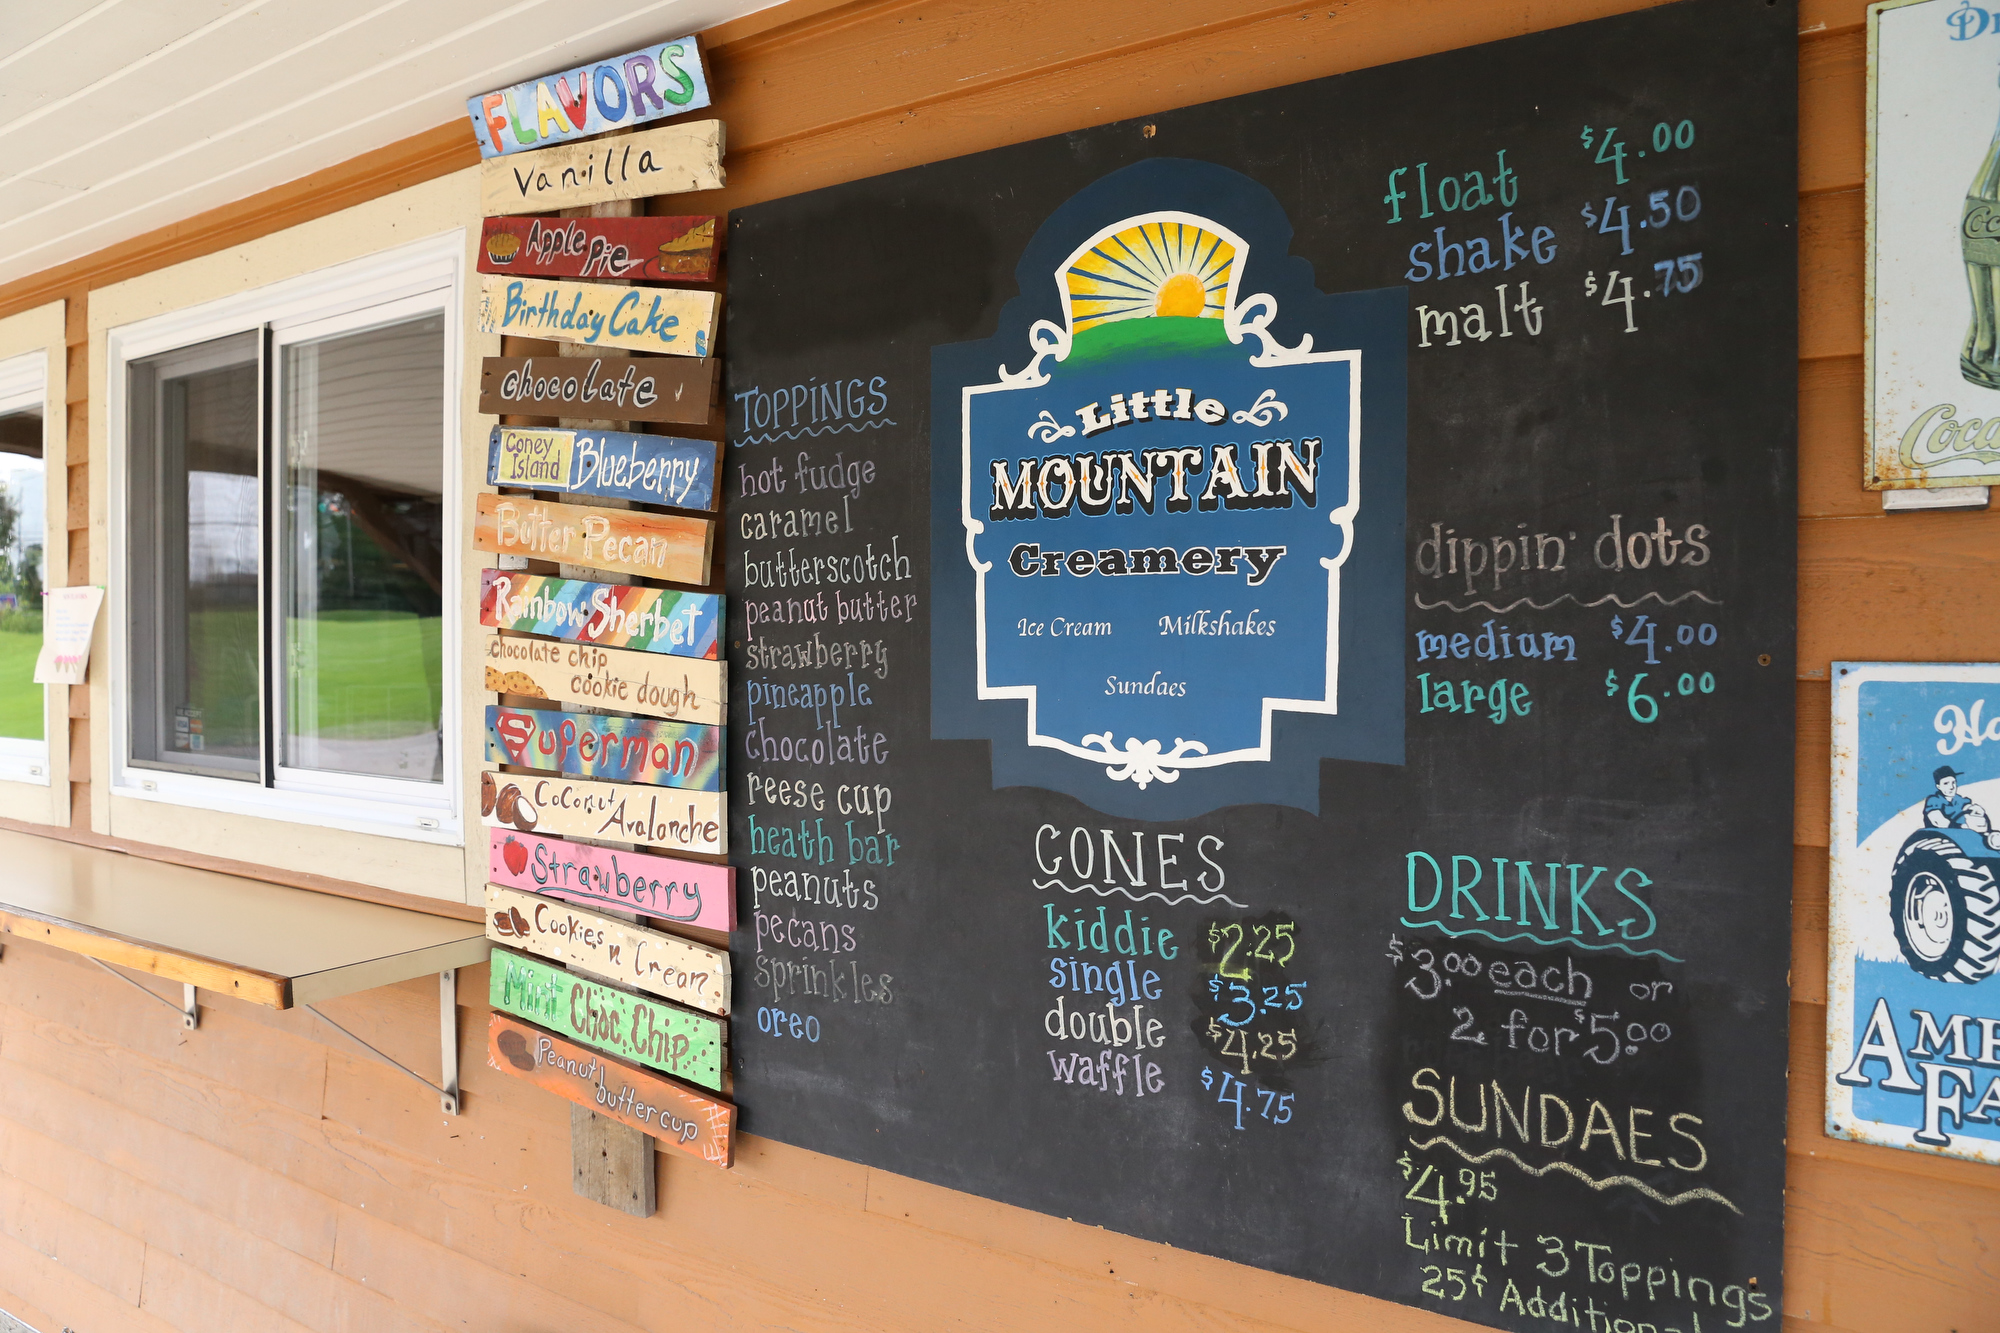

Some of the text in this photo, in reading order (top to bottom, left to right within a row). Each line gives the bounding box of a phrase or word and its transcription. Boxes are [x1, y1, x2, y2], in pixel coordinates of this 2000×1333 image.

[482, 44, 695, 152] FLAVORS
[513, 144, 664, 197] Vanilla
[1384, 119, 1695, 224] float $4.00
[526, 219, 587, 265] Apple
[1404, 185, 1701, 282] shake $4.50
[502, 281, 606, 343] Birthday
[608, 290, 679, 342] Cake
[1415, 252, 1703, 347] malt $4.75
[1075, 388, 1228, 438] Little
[506, 433, 553, 459] Coney
[510, 450, 561, 480] Island
[571, 438, 699, 504] Blueberry
[739, 452, 876, 499] hot fudge
[989, 436, 1323, 521] MOUNTAIN
[495, 502, 668, 568] Butter Pecan
[741, 495, 853, 540] caramel
[1594, 514, 1710, 572] dots
[744, 535, 912, 588] butterscotch
[1008, 543, 1286, 586] Creamery
[493, 576, 703, 646] Rainbow Sherbet
[745, 590, 917, 641] peanut butter
[1017, 609, 1276, 637] Ice Cream Milkshakes
[491, 639, 608, 675] chocolate chip
[746, 632, 888, 680] strawberry
[1415, 615, 1717, 665] medium $4.00
[571, 671, 701, 717] cookie dough
[747, 672, 872, 730] pineapple
[1105, 671, 1186, 697] Sundaes
[1416, 669, 1715, 724] large $6.00
[745, 717, 889, 765] chocolate
[747, 772, 892, 834] reese cup
[748, 814, 900, 866] heath bar
[1035, 824, 1225, 892] CONES
[532, 843, 702, 922] Strawberry
[751, 866, 879, 910] peanuts
[1405, 851, 1656, 940] DRINKS
[535, 904, 605, 946] Cookies
[634, 941, 709, 996] Cream
[754, 910, 857, 953] pecans
[1043, 904, 1295, 982] kiddie $2.25
[754, 955, 894, 1005] sprinkles
[1049, 957, 1307, 1027] single $3.25
[1488, 957, 1592, 1000] each
[1629, 980, 1673, 1001] or
[503, 960, 563, 1022] Mint
[631, 1004, 690, 1071] Chip
[757, 1006, 820, 1042] oreo
[1045, 996, 1298, 1074] double $4.25
[1450, 1006, 1488, 1045] 2
[1501, 1009, 1580, 1055] for
[537, 1038, 597, 1080] Peanut
[1047, 1050, 1295, 1130] waffle $4.75
[1402, 1067, 1707, 1172] SUNDAES
[1396, 1151, 1497, 1224] $4.95
[1401, 1212, 1773, 1328] Limit 3 Toppings
[1500, 1278, 1701, 1333] Additionl
